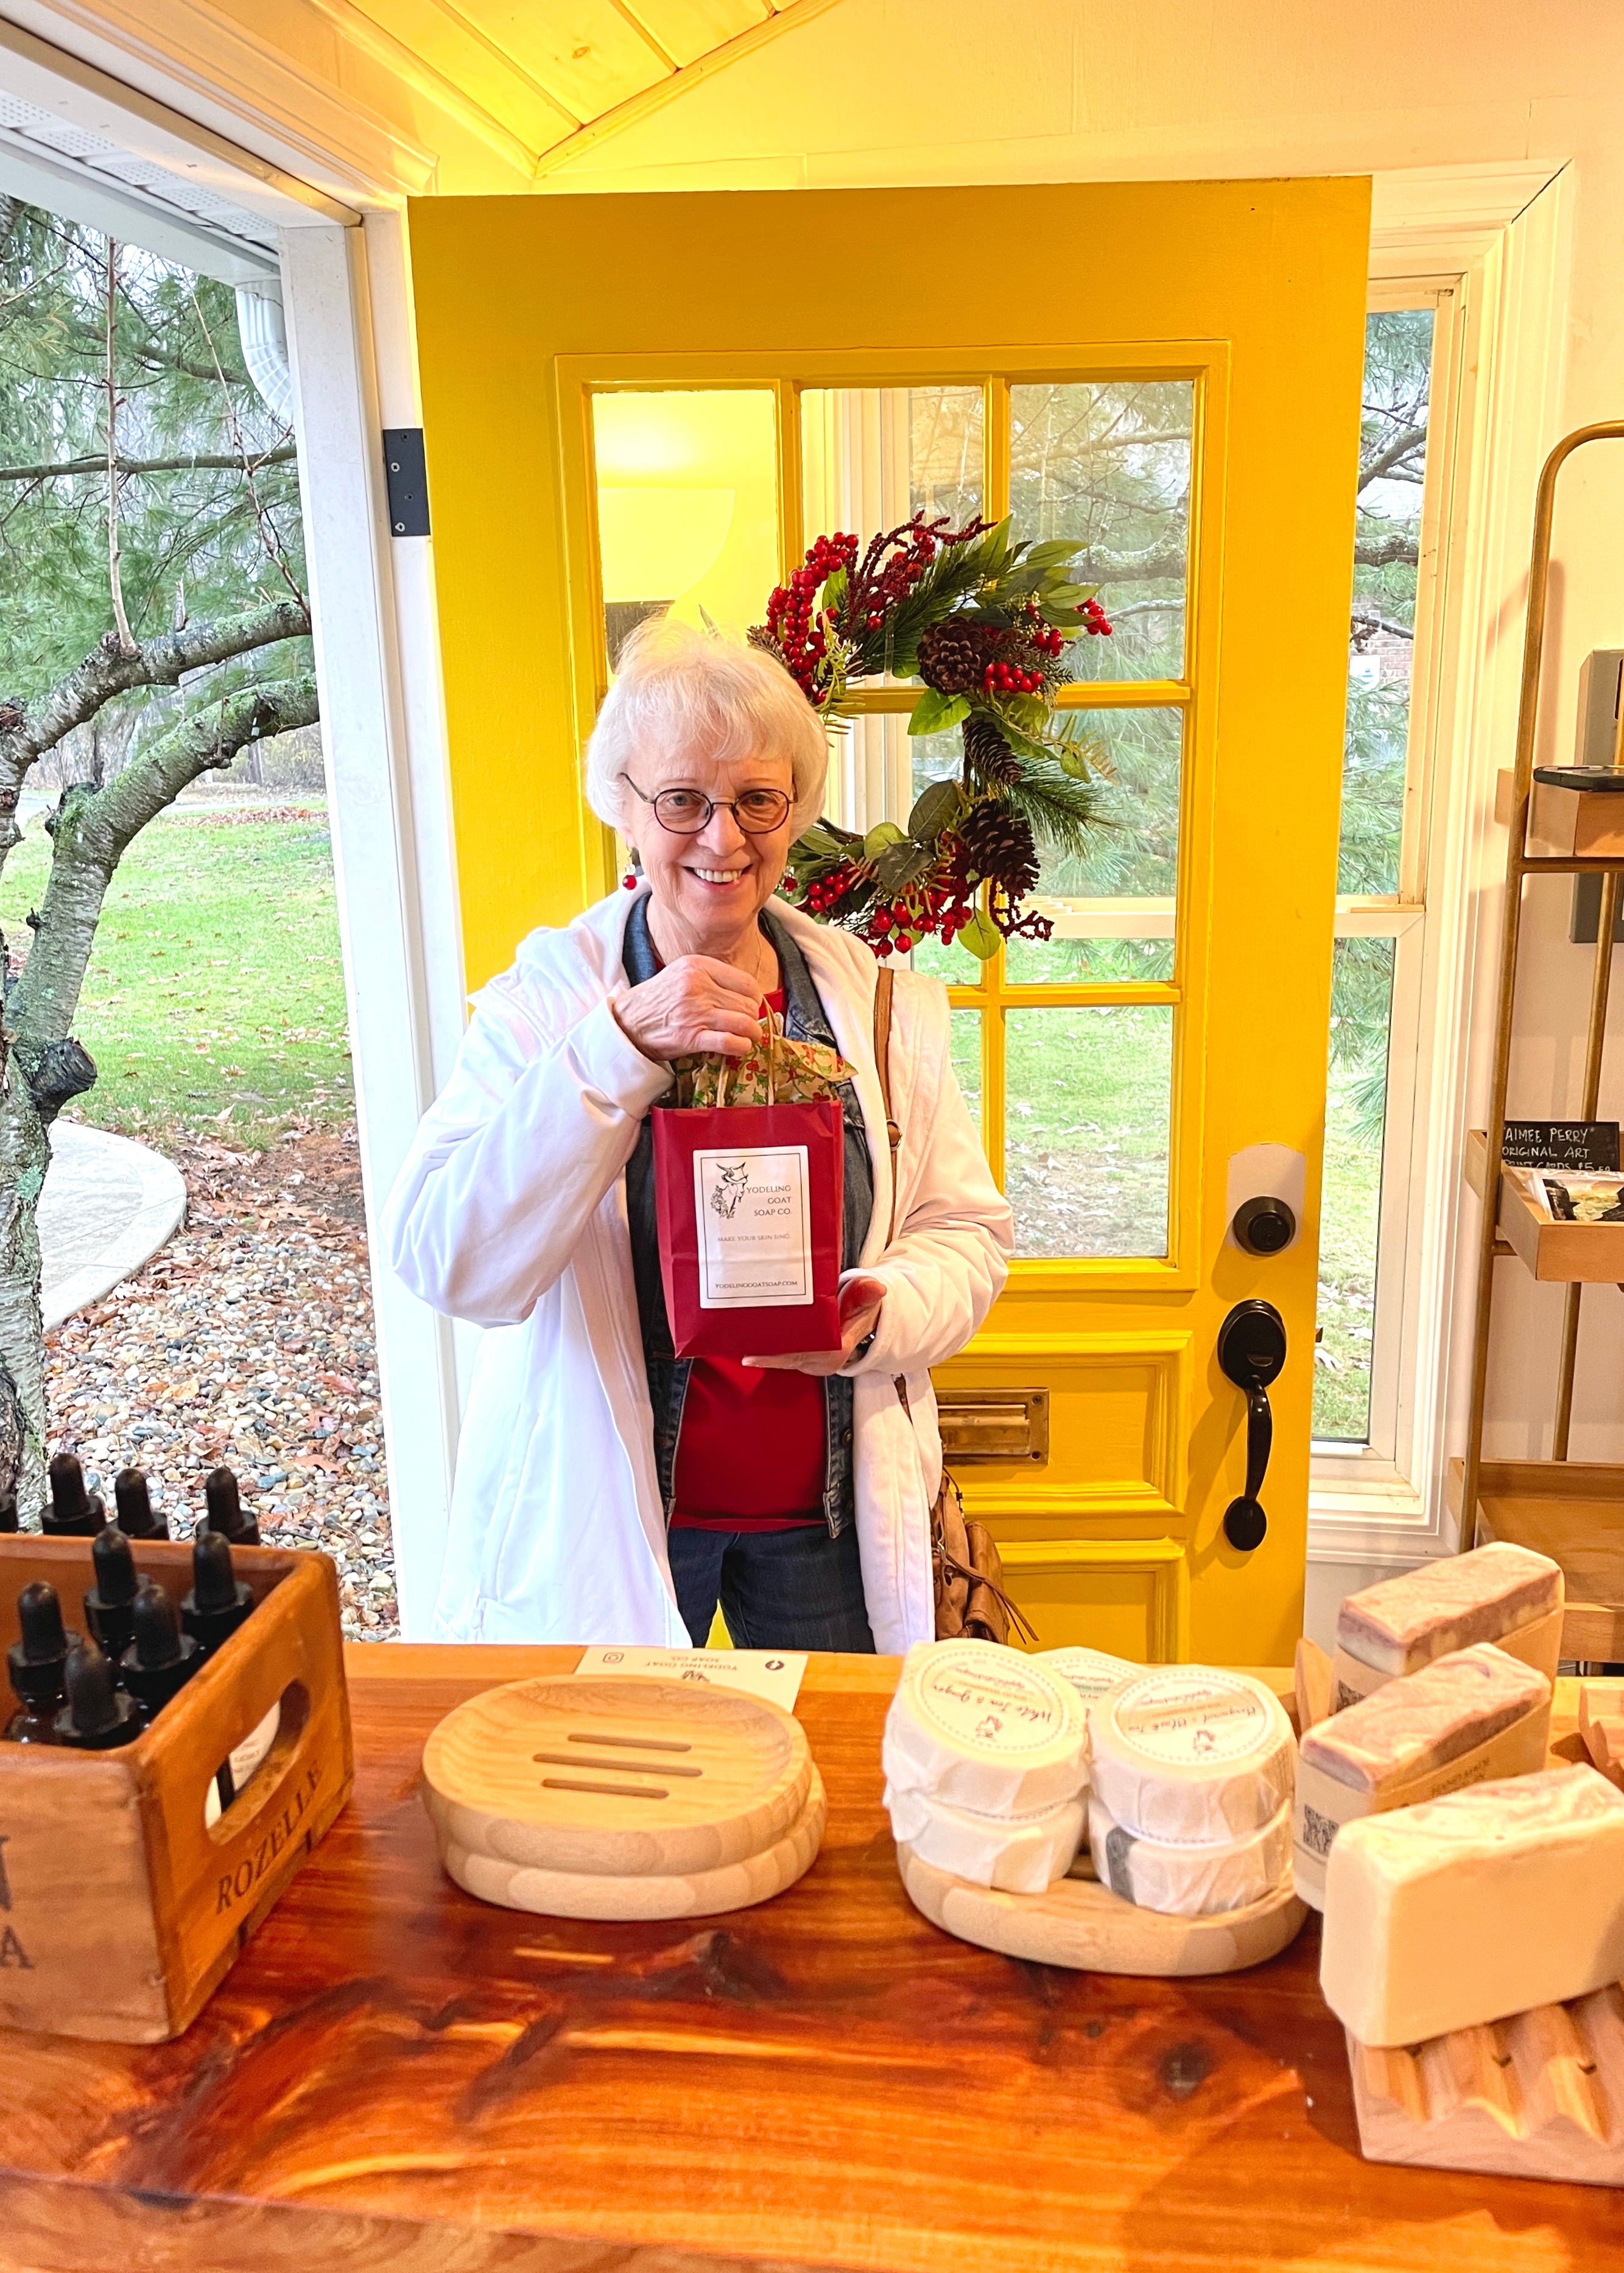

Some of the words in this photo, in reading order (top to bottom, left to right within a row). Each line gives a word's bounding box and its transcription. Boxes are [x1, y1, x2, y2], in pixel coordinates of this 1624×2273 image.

[1505, 1127, 1542, 1143] AIMEE
[1550, 1127, 1588, 1144] PERRY
[1502, 1147, 1558, 1157] ORIGINAL
[1564, 1148, 1591, 1158] ART
[747, 1185, 792, 1194] YODELING
[680, 1662, 737, 1671] YODELING
[216, 1759, 323, 1915] ROZELLE
